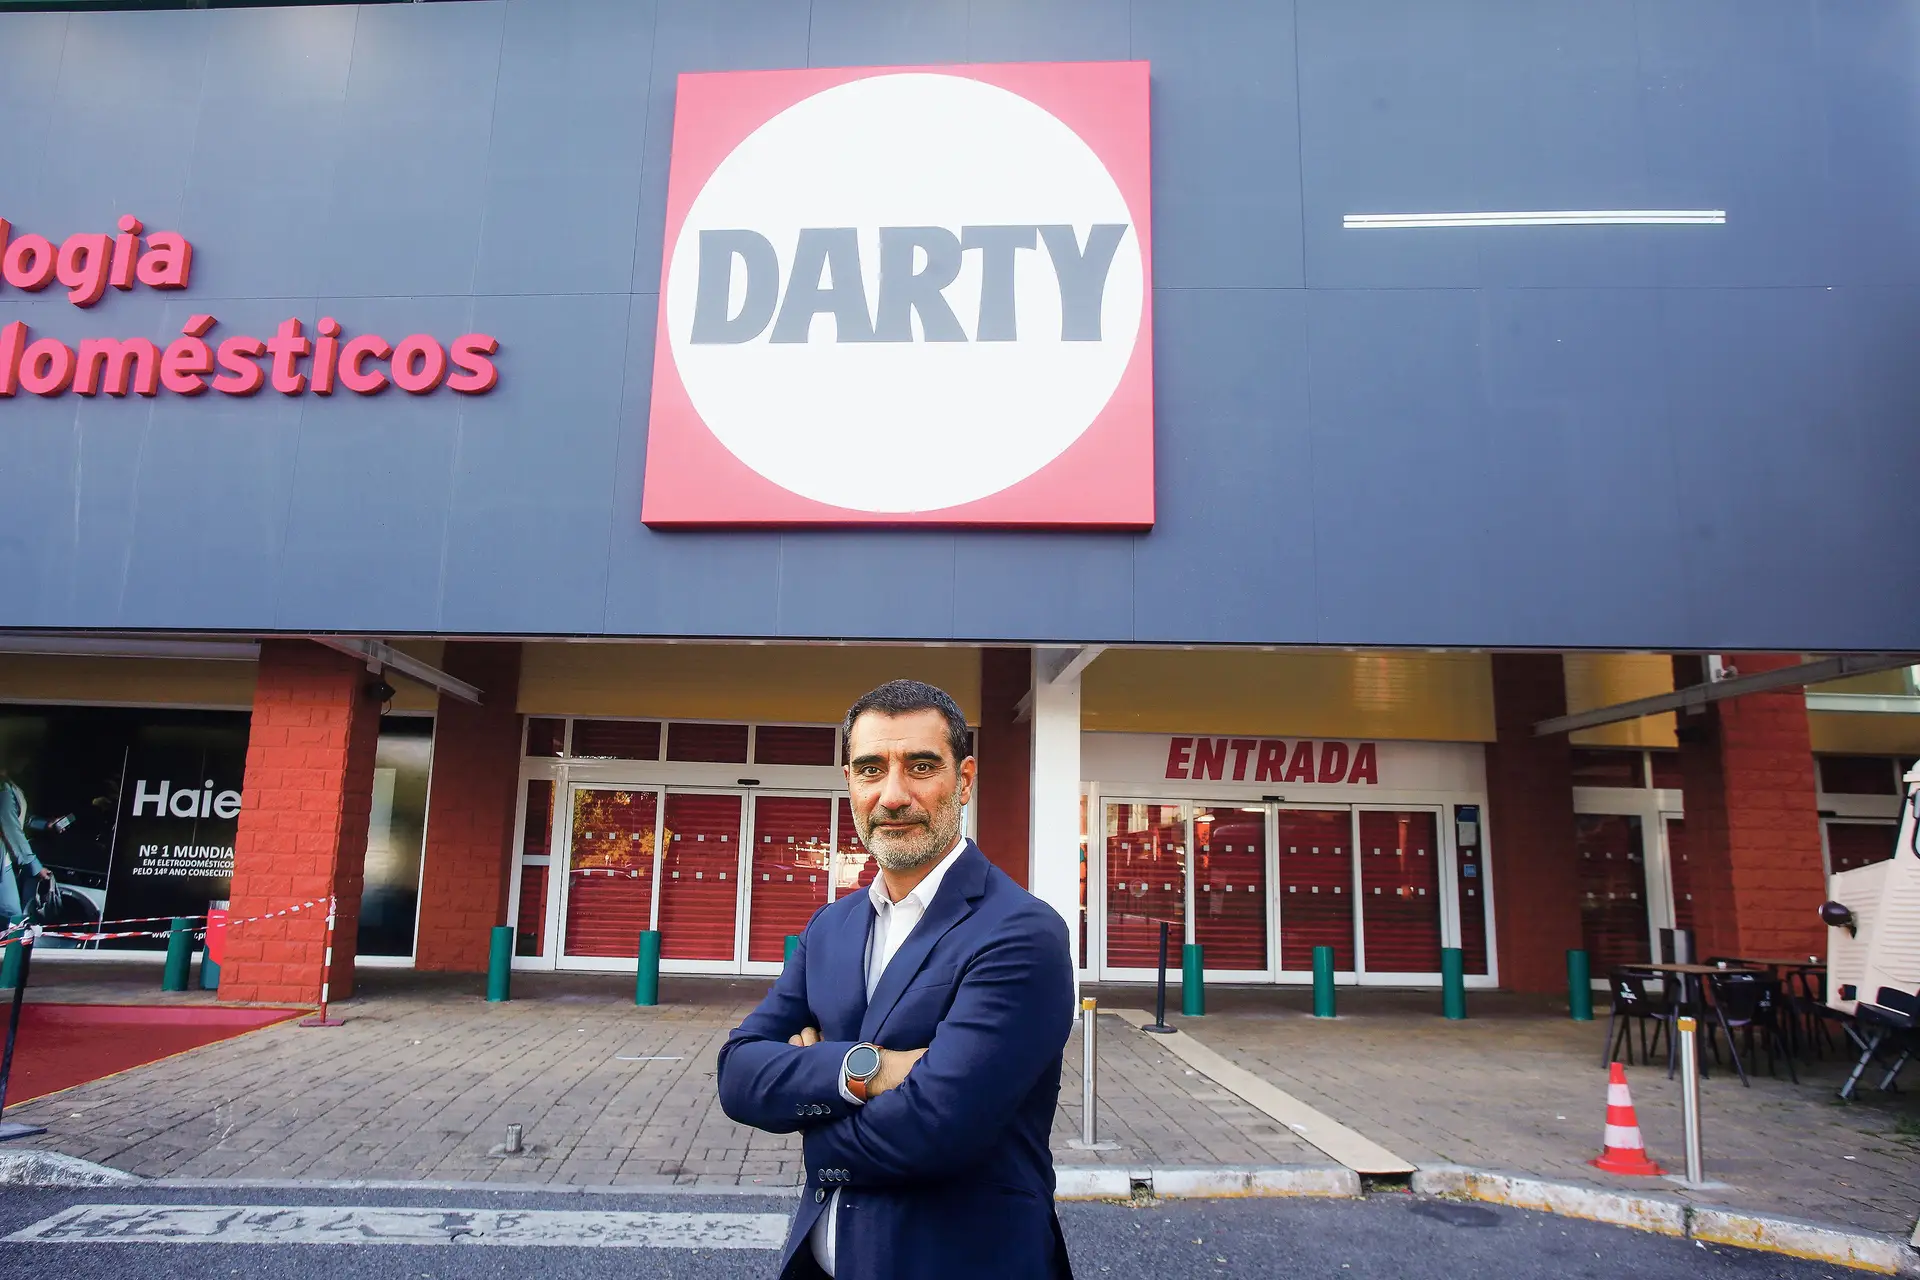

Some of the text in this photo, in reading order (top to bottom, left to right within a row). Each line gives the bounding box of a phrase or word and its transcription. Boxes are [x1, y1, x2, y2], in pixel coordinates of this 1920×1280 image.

[690, 224, 1128, 345] DARTY
[1165, 737, 1378, 784] ENTRADA
[139, 844, 236, 860] Nº 1 MUNDIA
[142, 858, 235, 869] EM ELETRODOMÉSTICOS
[132, 867, 153, 876] PELO
[168, 868, 187, 877] ANO
